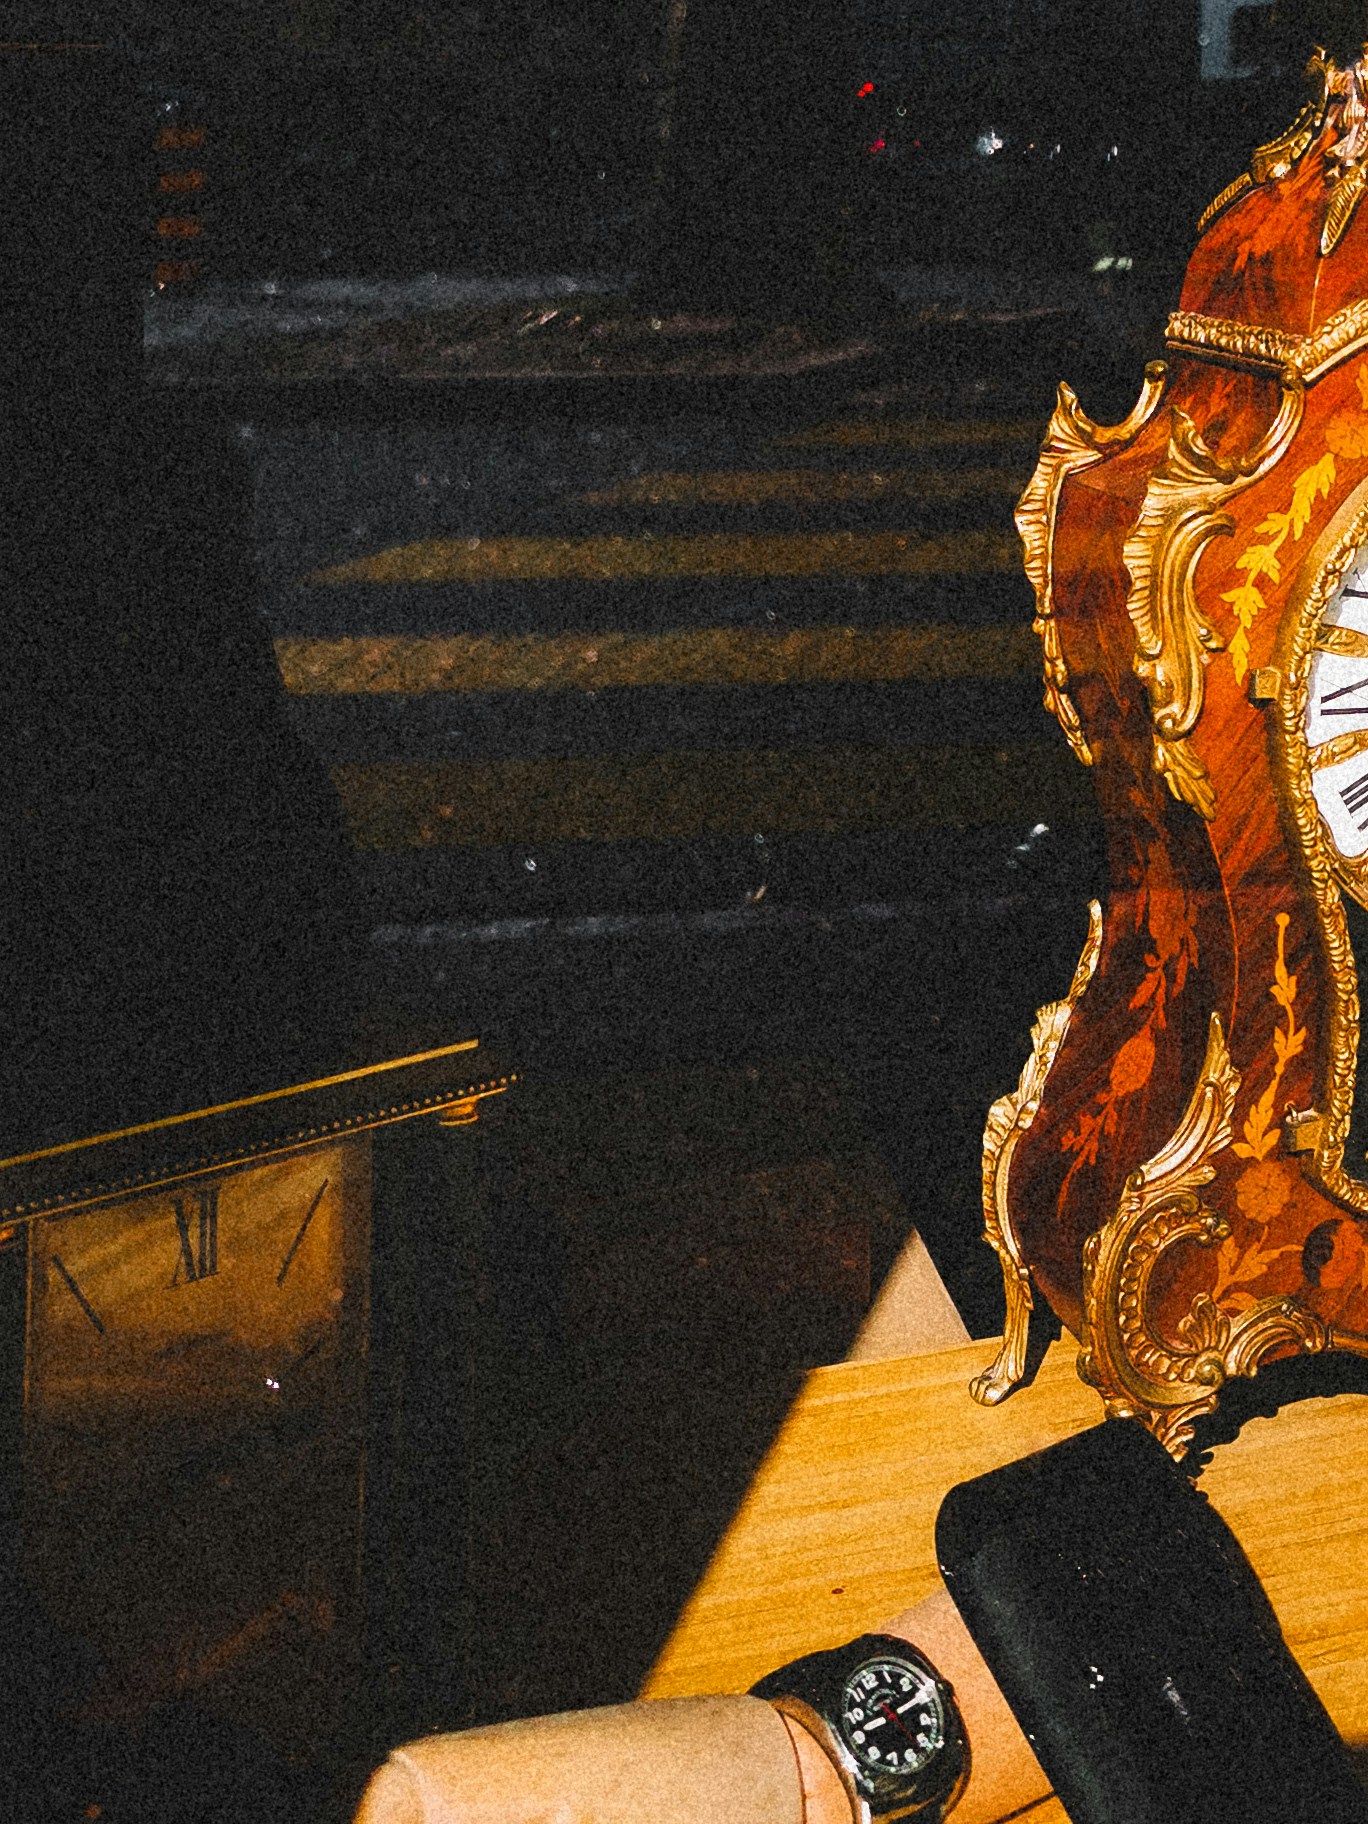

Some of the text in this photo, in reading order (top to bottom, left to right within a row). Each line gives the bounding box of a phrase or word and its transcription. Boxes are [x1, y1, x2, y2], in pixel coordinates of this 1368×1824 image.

[861, 1673, 879, 1690] 12
[883, 1670, 892, 1684] 1
[899, 1676, 913, 1692] 2
[847, 1687, 866, 1703] 11
[845, 1708, 864, 1725] 10
[886, 1751, 899, 1765] 7
